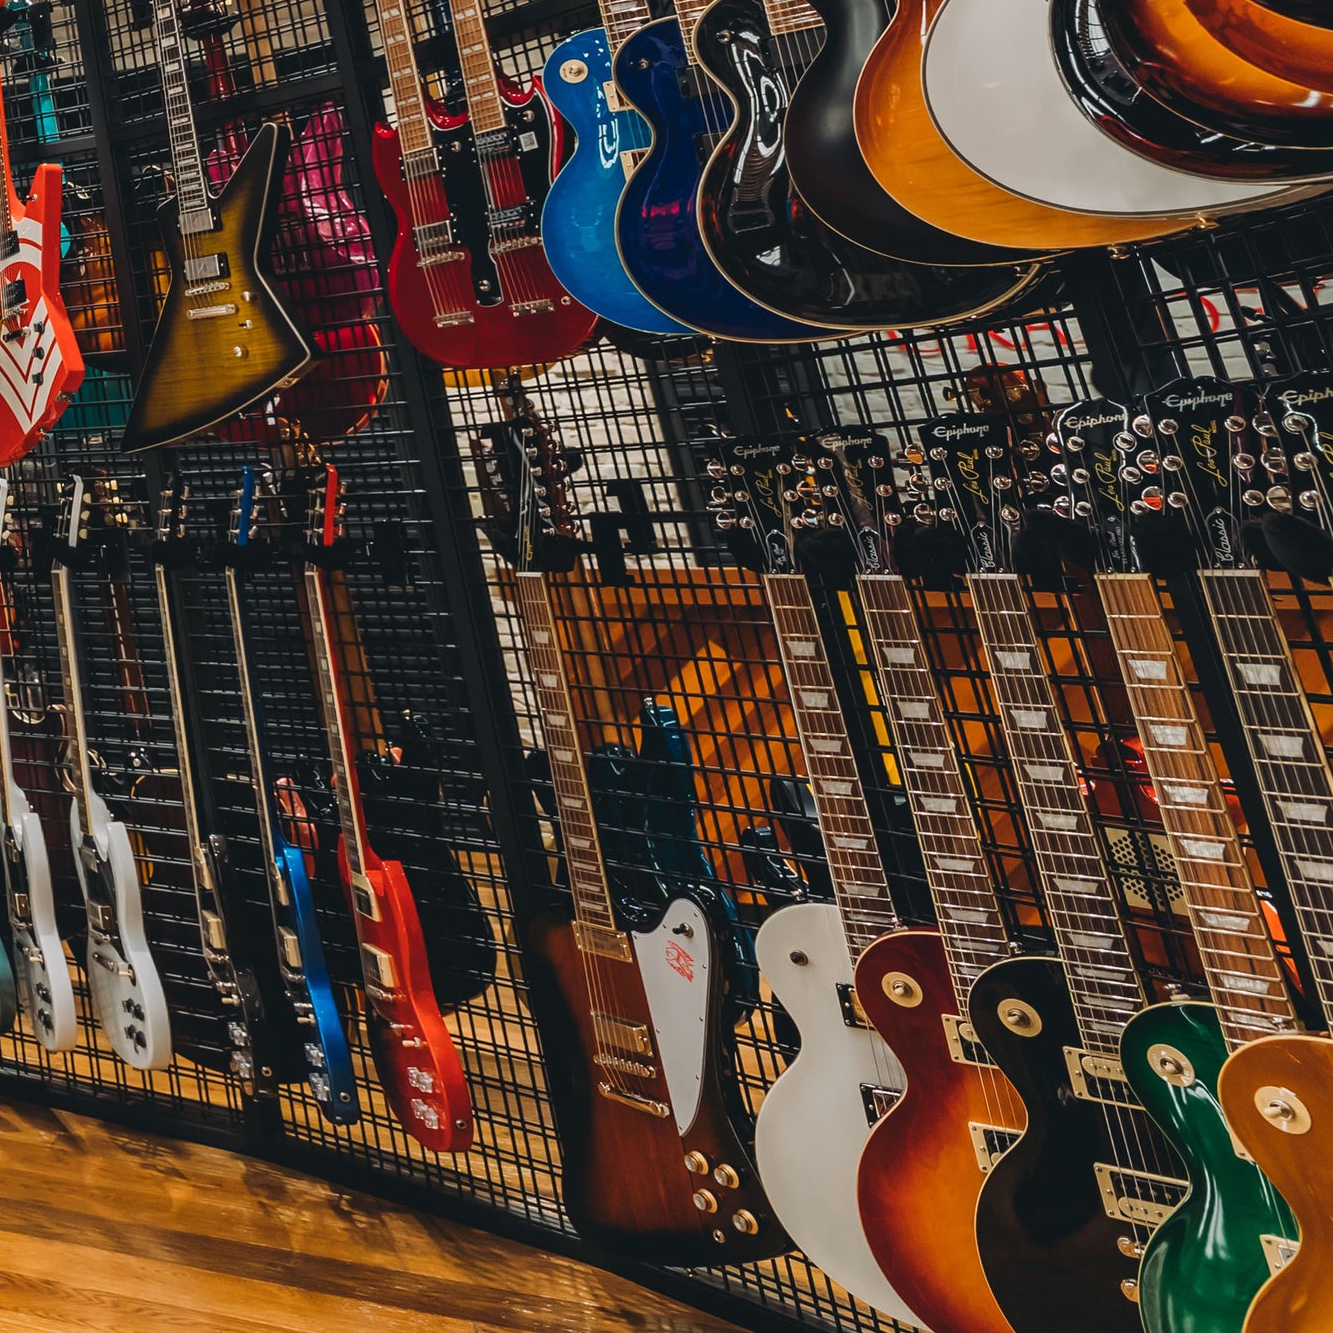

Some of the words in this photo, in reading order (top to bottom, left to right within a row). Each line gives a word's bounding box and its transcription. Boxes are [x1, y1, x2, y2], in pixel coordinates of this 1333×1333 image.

[1162, 391, 1233, 412] Epiphone
[821, 435, 873, 451] Epiphone
[933, 423, 990, 443] Epiphone
[1190, 423, 1218, 459] Paul
[733, 443, 781, 460] Epiphone
[957, 451, 983, 479] Paul
[1095, 452, 1117, 483] Paul
[865, 535, 881, 570] Classic
[978, 531, 996, 568] Classic
[1214, 518, 1234, 563] Classic
